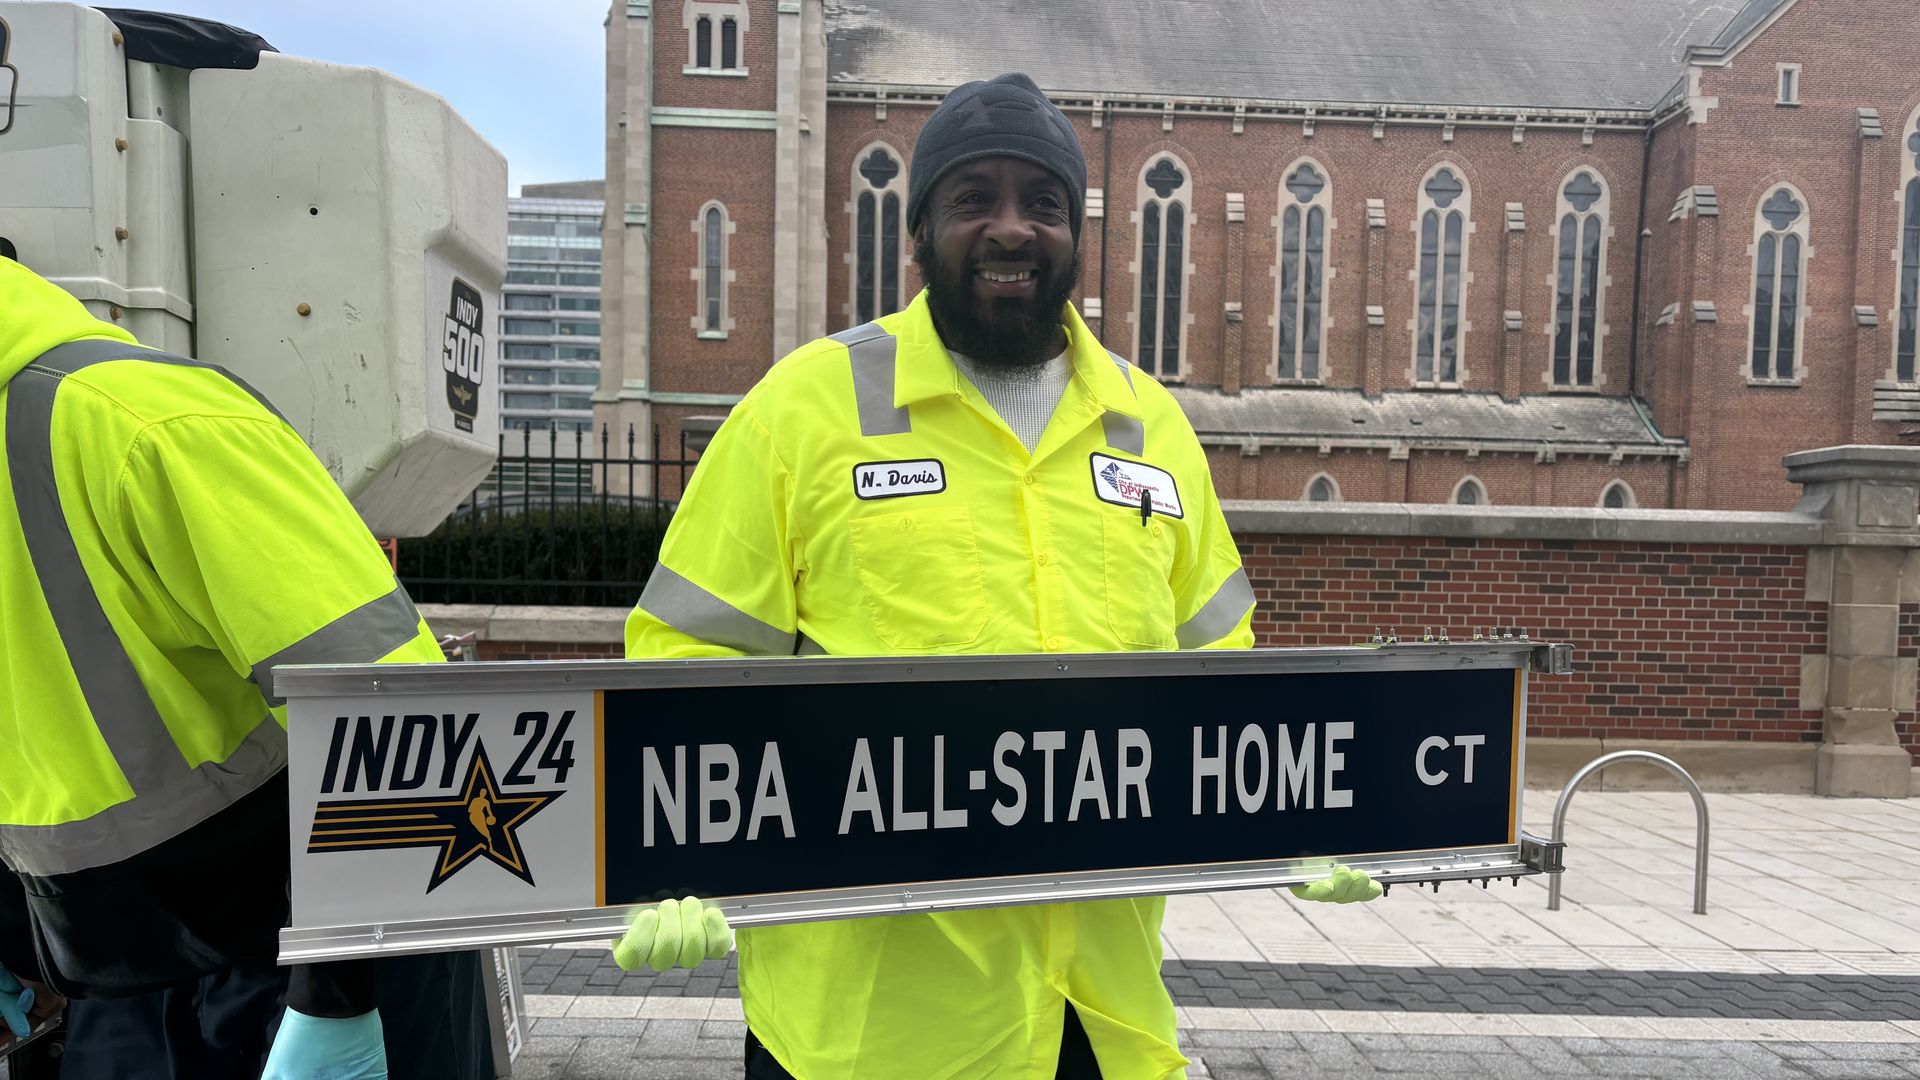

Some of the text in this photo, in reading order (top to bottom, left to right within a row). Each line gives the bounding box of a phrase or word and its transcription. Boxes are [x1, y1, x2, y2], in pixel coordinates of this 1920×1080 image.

[456, 296, 478, 328] INDY
[443, 316, 484, 385] 500
[861, 469, 938, 488] N. Davis
[320, 710, 577, 794] INDY 24
[643, 721, 1486, 847] NBA ALL-STAR HOME CT
